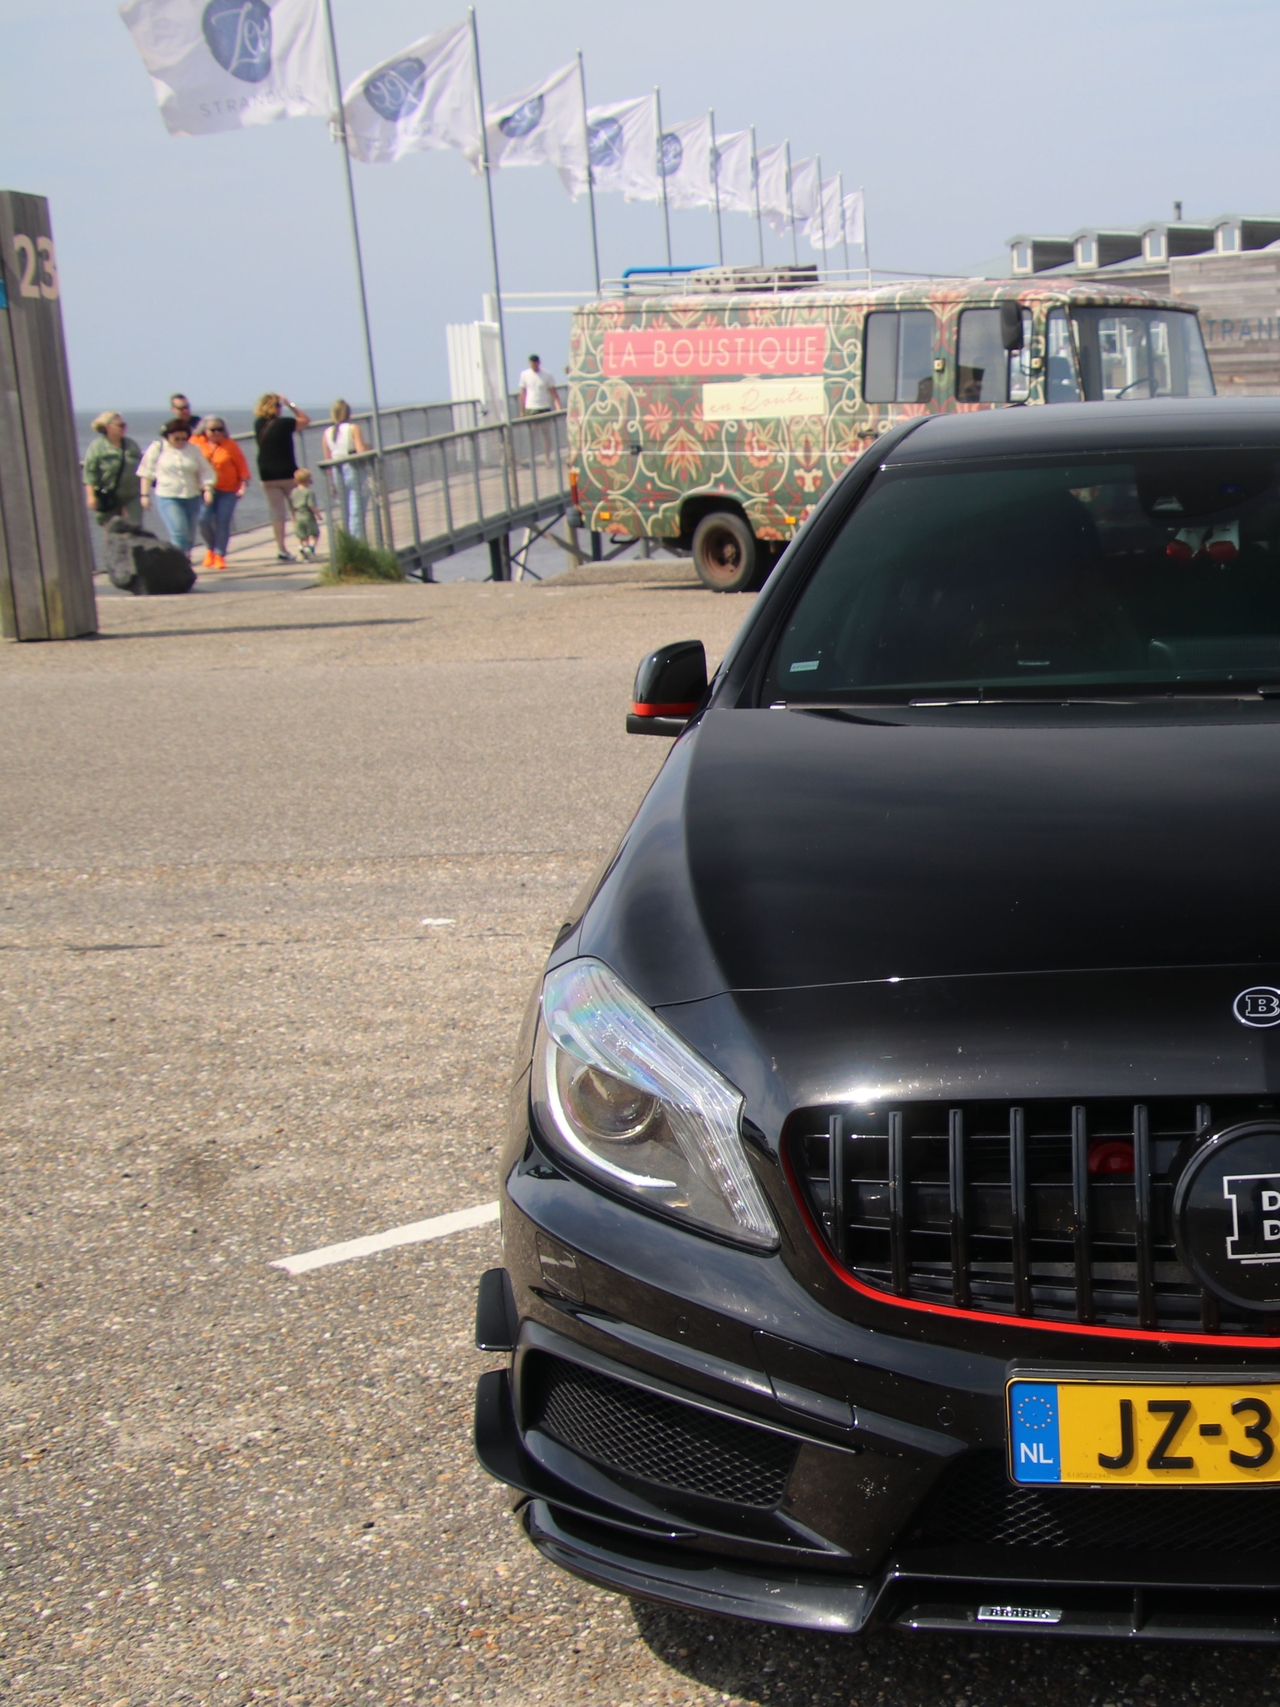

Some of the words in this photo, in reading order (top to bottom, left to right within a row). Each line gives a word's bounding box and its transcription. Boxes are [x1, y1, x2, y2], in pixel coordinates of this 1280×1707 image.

[13, 233, 58, 299] 23
[608, 341, 637, 369] LA
[653, 336, 818, 369] BOUSTIQUE
[1245, 994, 1280, 1017] B
[1020, 1442, 1054, 1464] NL
